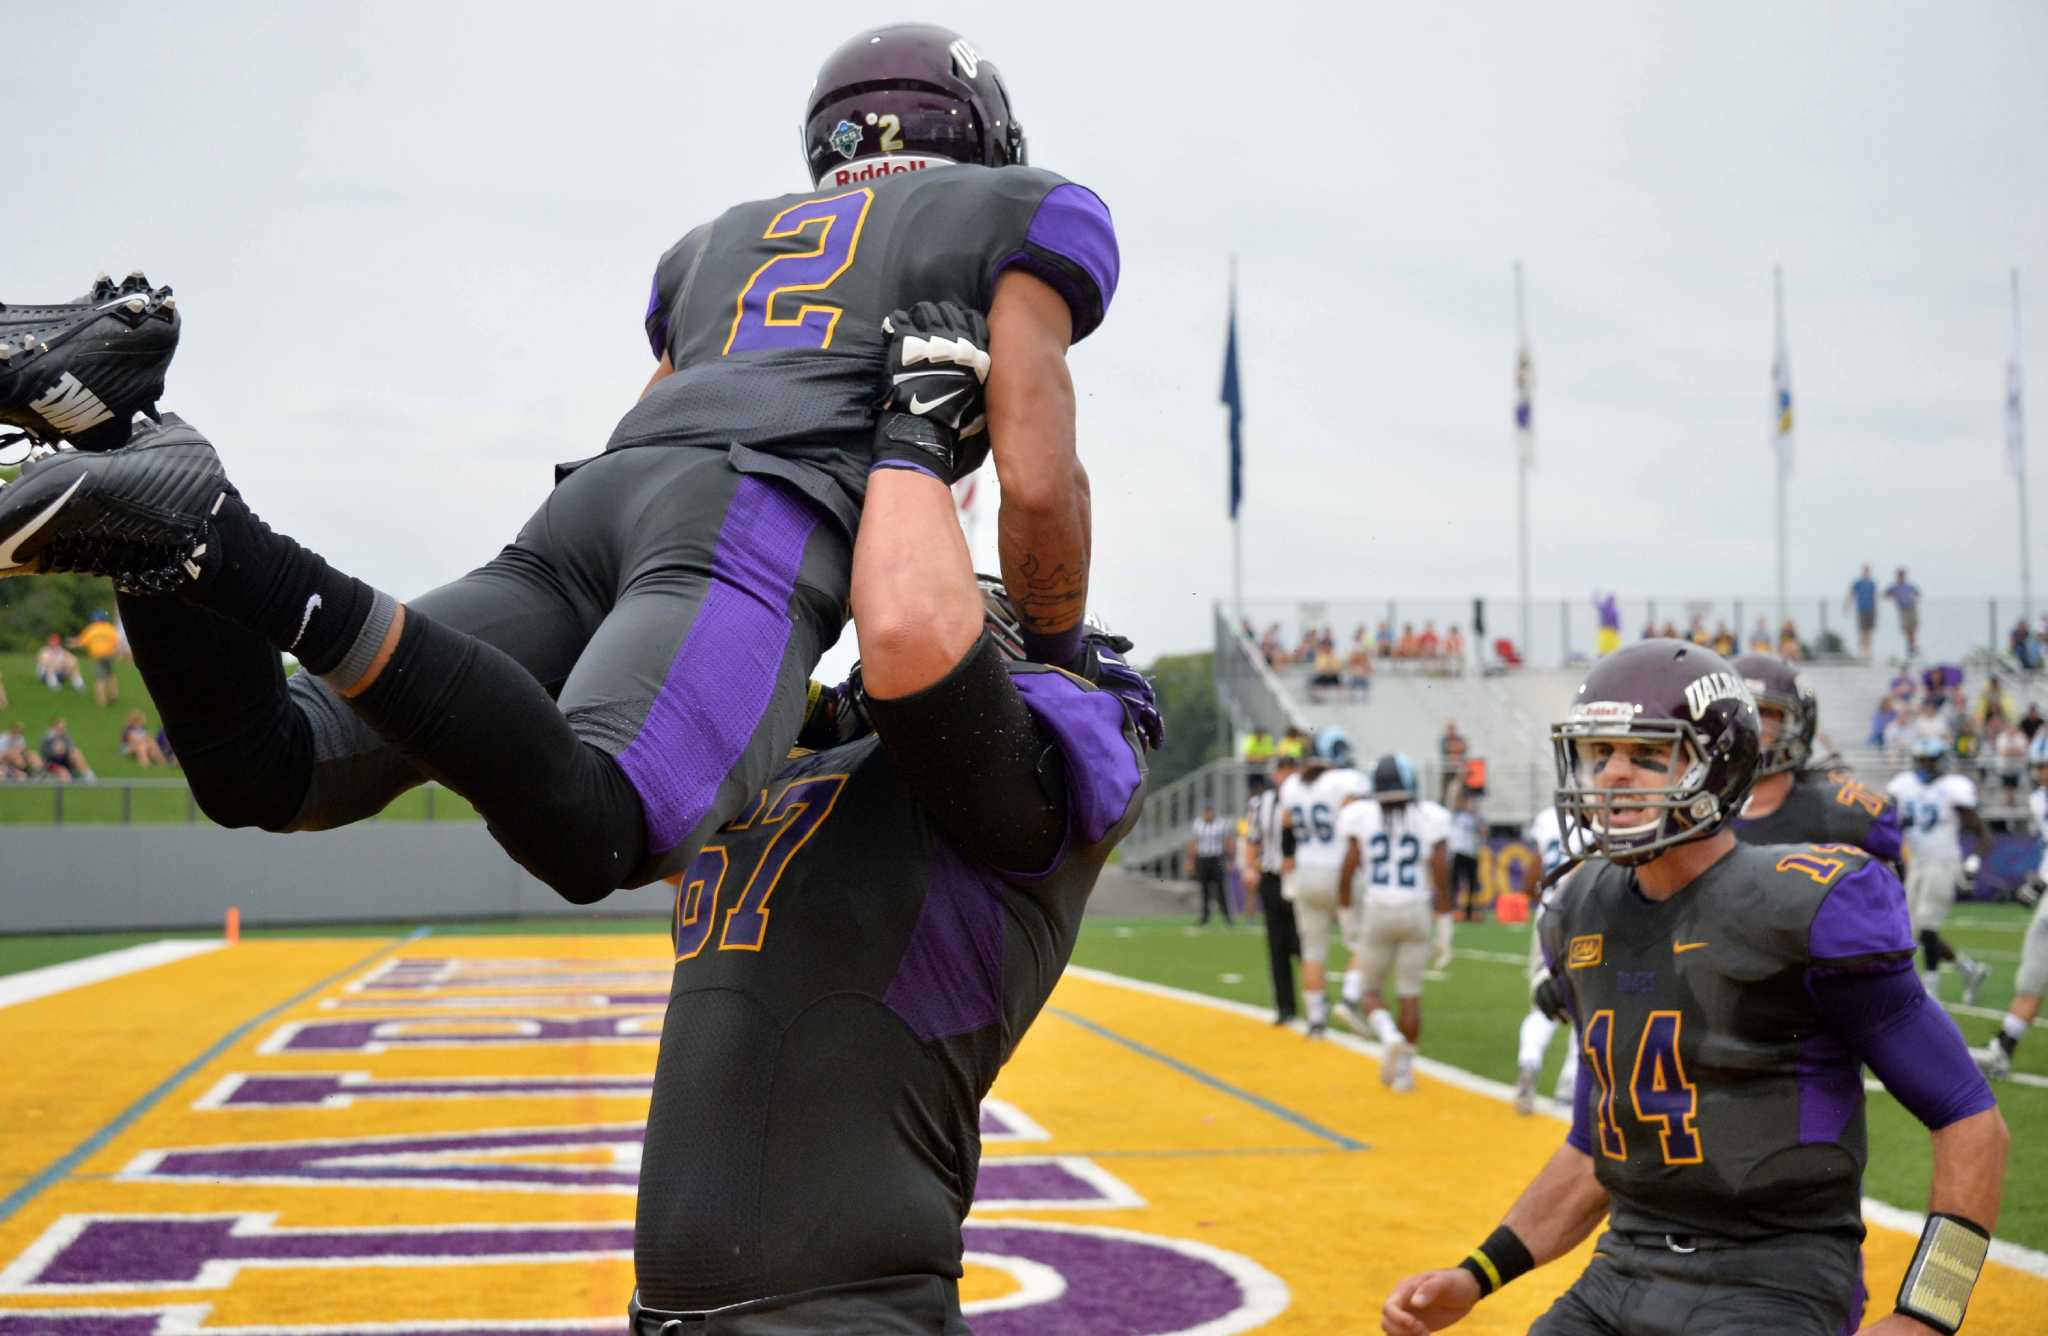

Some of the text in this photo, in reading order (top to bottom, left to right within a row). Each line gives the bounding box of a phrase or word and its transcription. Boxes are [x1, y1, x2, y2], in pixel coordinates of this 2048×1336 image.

[879, 114, 904, 151] 2
[721, 187, 875, 357] 2
[1370, 833, 1421, 888] 22
[1584, 1009, 1703, 1164] 14
